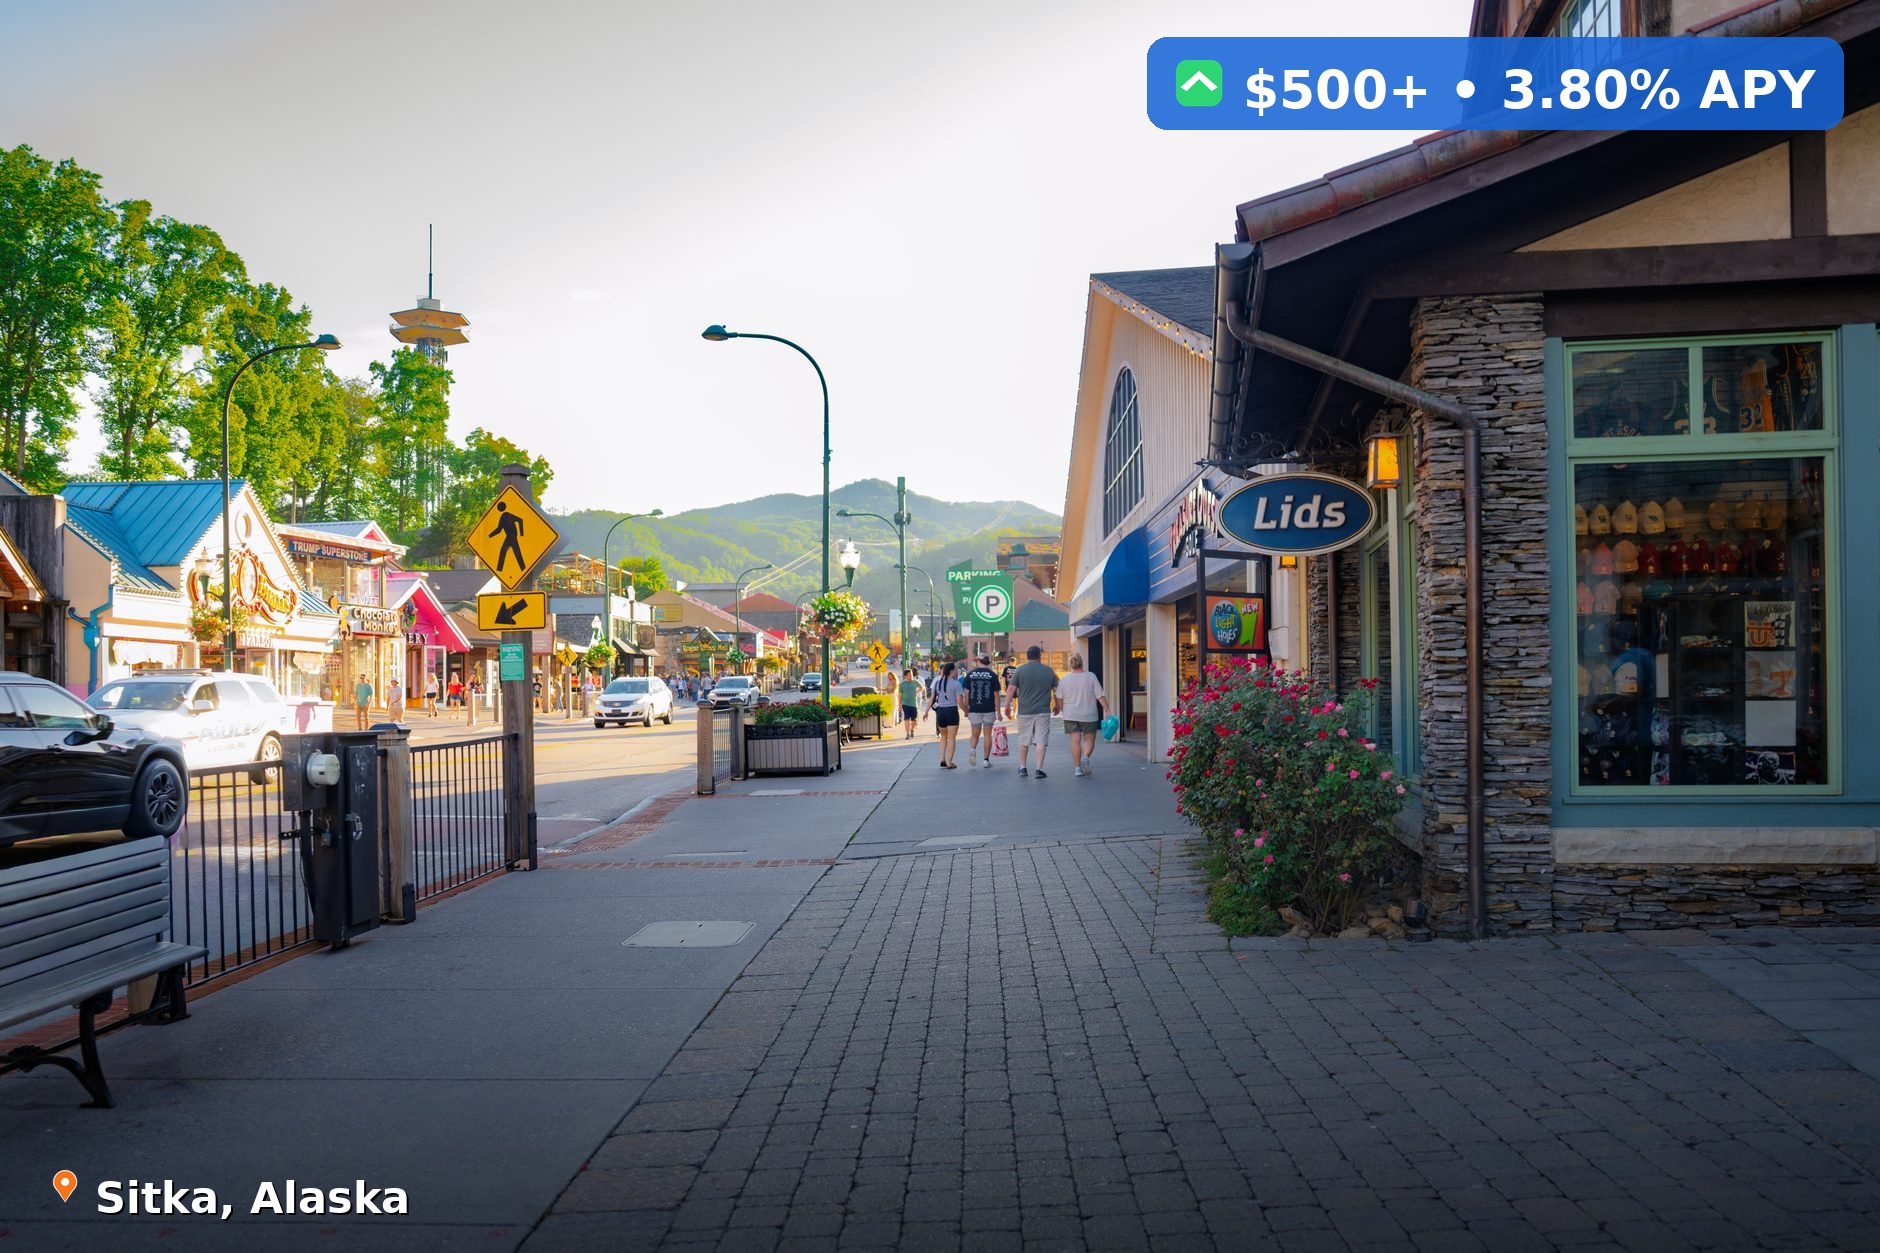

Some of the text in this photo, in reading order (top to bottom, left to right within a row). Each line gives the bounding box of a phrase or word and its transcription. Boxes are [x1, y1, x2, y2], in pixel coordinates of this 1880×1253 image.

[1254, 494, 1346, 530] Lids
[293, 541, 369, 562] TRUMP SUPERSTORE
[986, 595, 1000, 614] P
[1214, 603, 1237, 617] BLACK
[1241, 602, 1259, 615] NEW
[354, 607, 400, 623] Chocolate
[1215, 614, 1236, 629] LIGHT
[364, 620, 400, 636] Monkey
[1217, 628, 1238, 643] HOLES
[199, 722, 252, 741] POLICE
